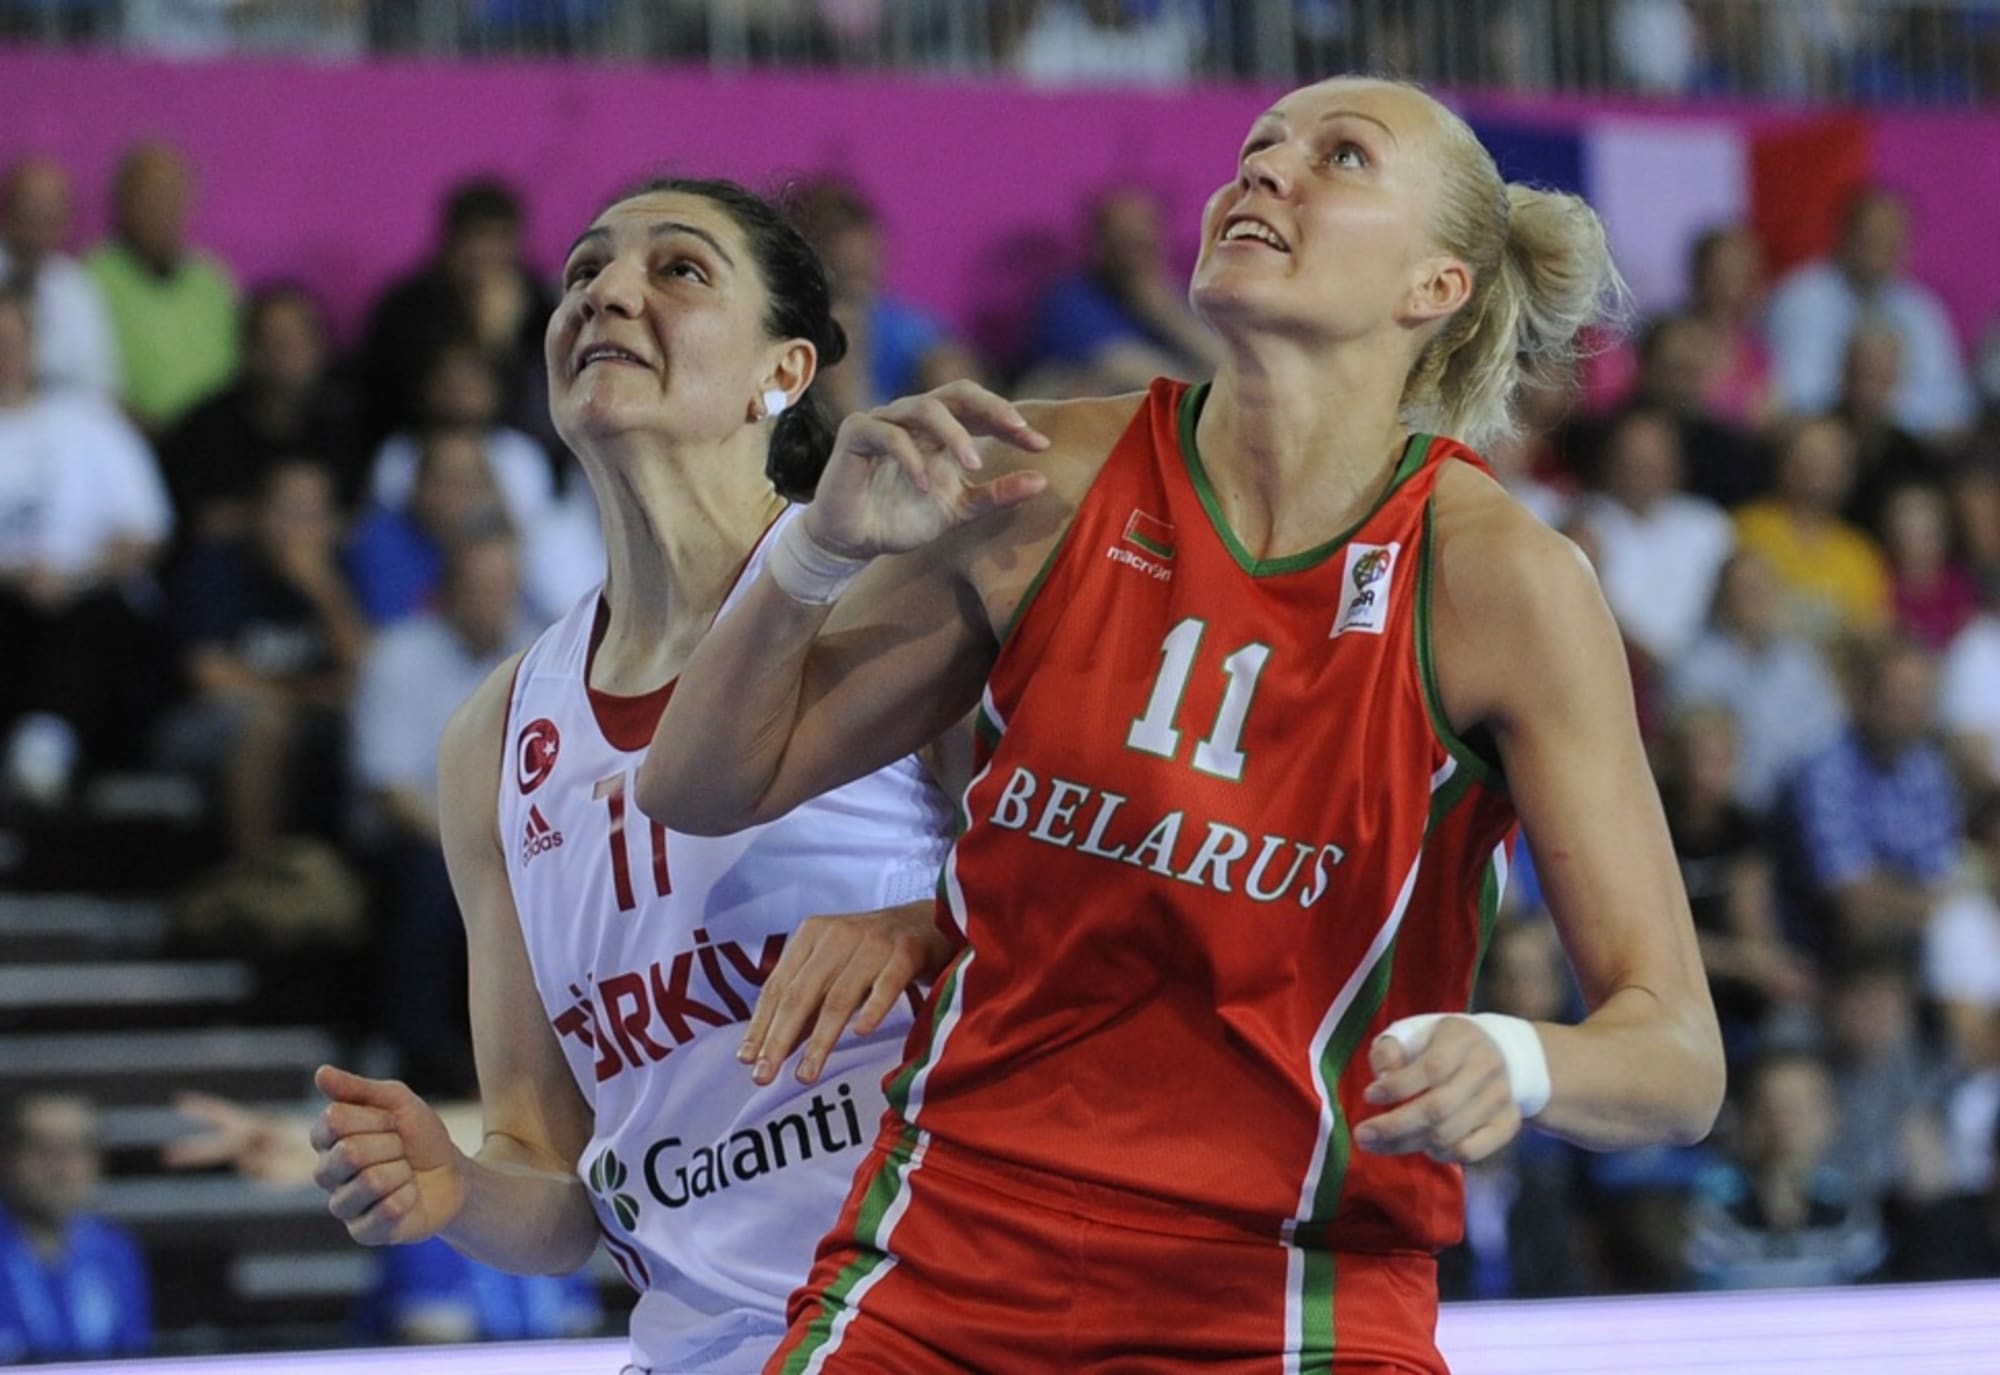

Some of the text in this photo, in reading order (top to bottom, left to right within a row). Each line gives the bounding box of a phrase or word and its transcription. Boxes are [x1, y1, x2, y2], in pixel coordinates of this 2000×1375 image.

[1125, 617, 1273, 782] 11
[989, 767, 1345, 909] BELARUS
[643, 1083, 863, 1208] Garanti
